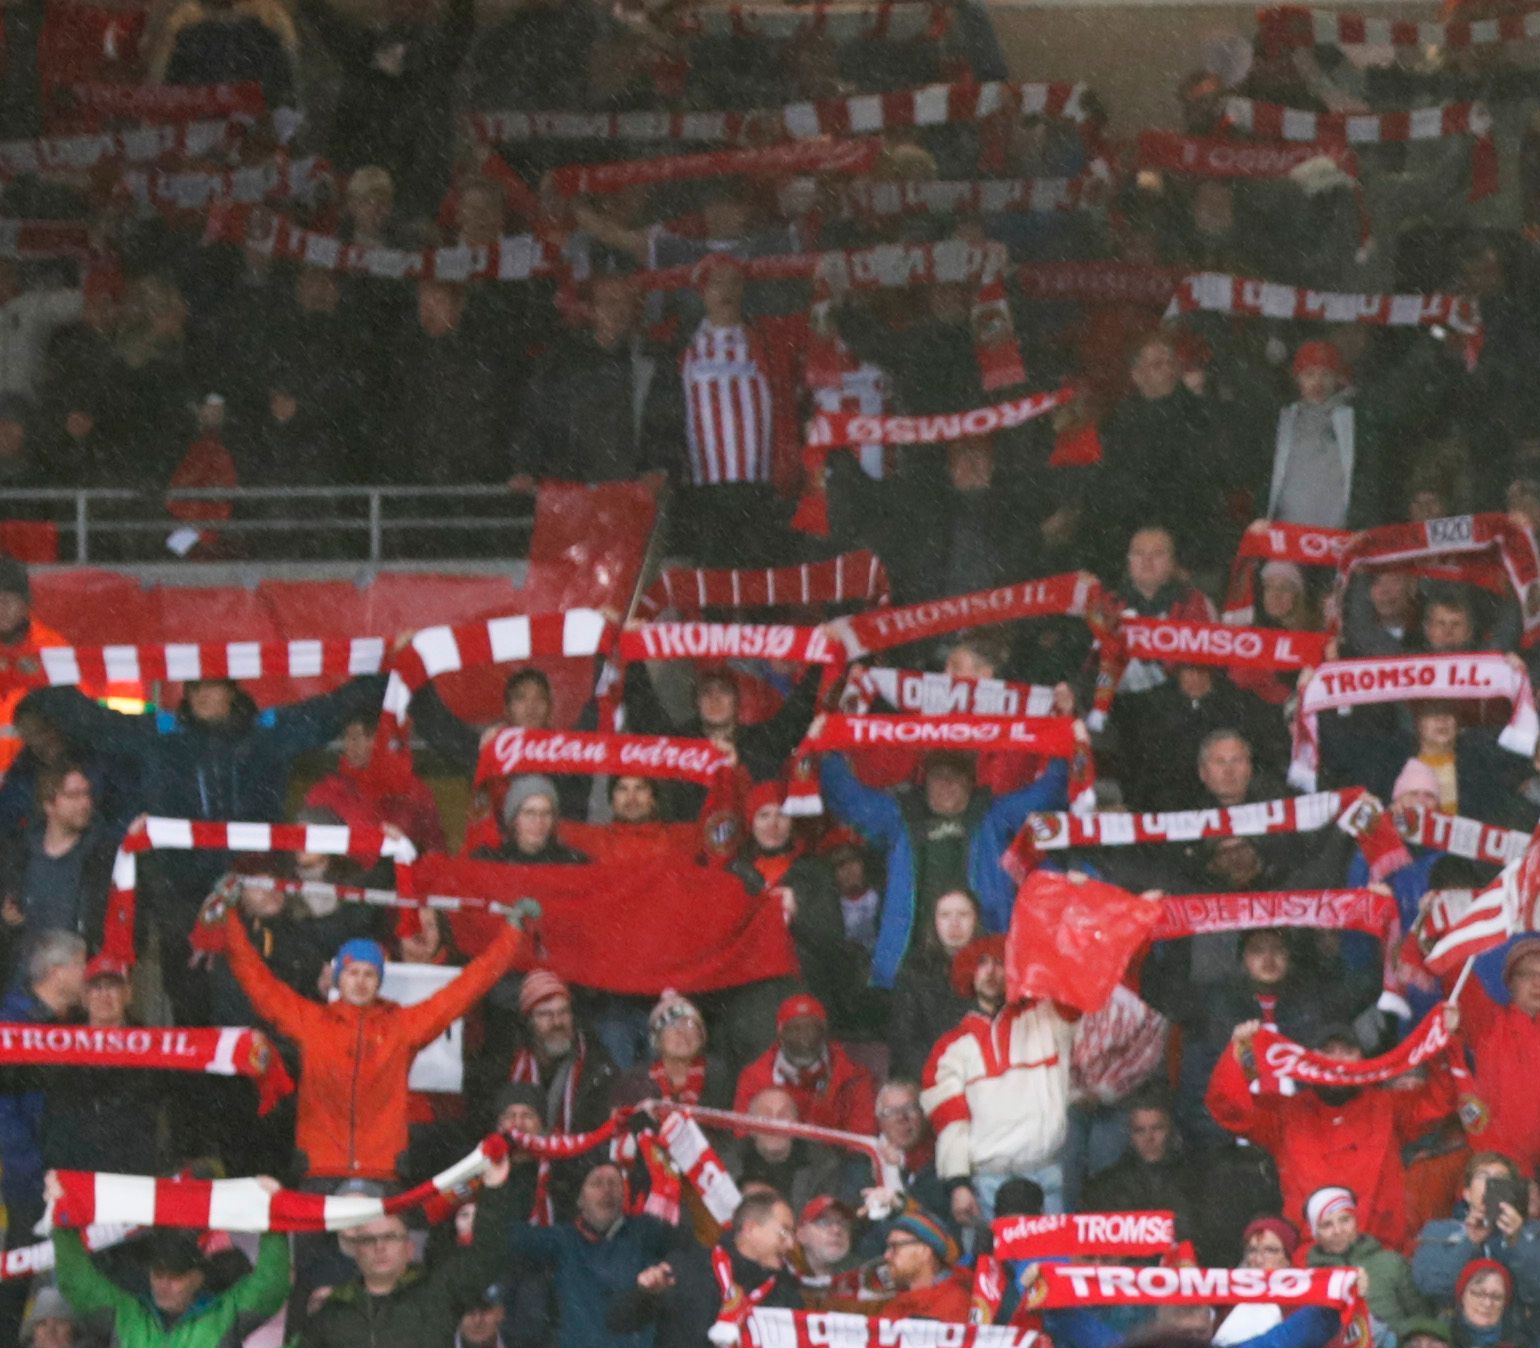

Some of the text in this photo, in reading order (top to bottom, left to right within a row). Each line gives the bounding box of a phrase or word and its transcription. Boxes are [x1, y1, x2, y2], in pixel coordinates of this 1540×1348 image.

[640, 622, 796, 658] TROMSØ
[1124, 626, 1263, 658] ROMSØ
[1320, 665, 1436, 695] TROMSØ
[494, 726, 607, 775] Gutan
[0, 1029, 197, 1057] TROMSØ IL
[1054, 1266, 1315, 1298] TROMSØ
